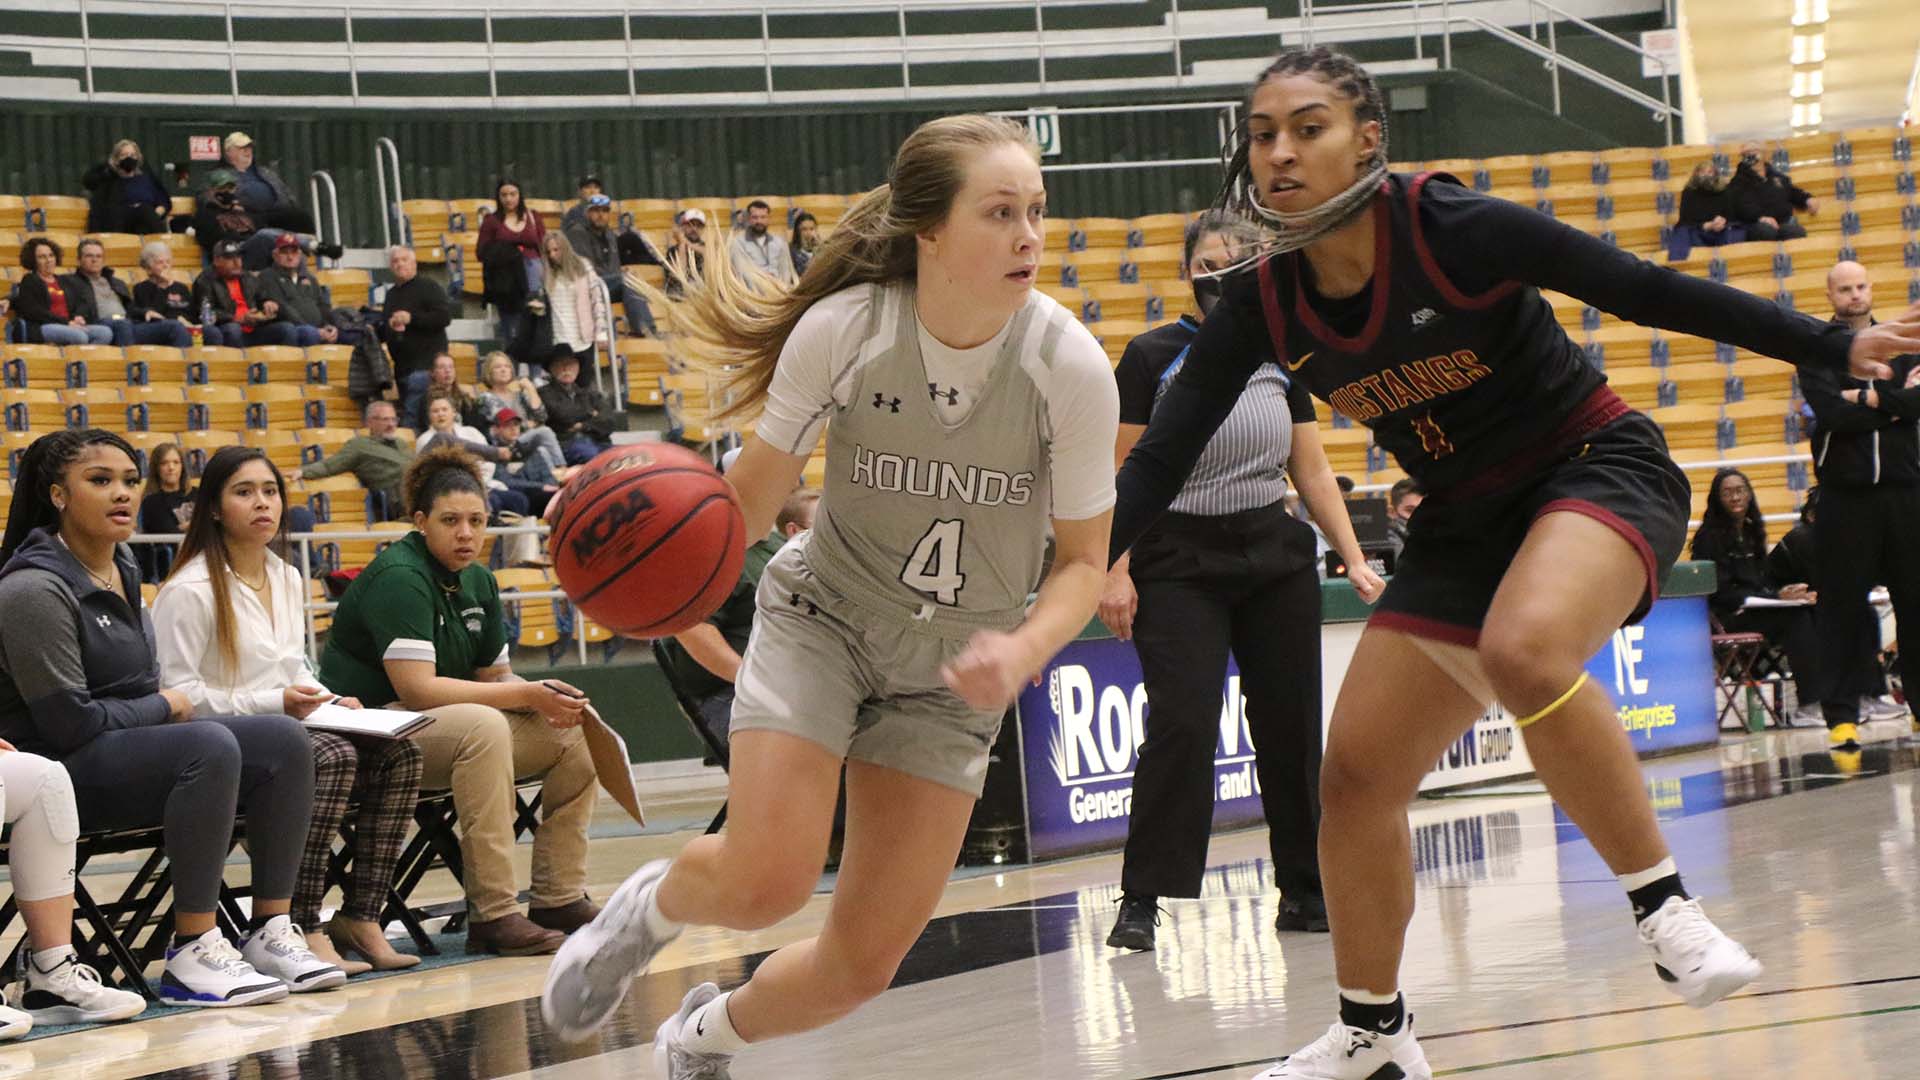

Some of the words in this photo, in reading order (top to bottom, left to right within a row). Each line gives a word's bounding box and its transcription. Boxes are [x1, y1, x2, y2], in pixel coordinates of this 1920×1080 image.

[851, 443, 1036, 507] HOUNDS
[571, 487, 657, 568] NCAA
[899, 518, 966, 606] 4
[1480, 726, 1512, 764] GROUP
[1219, 762, 1251, 801] and
